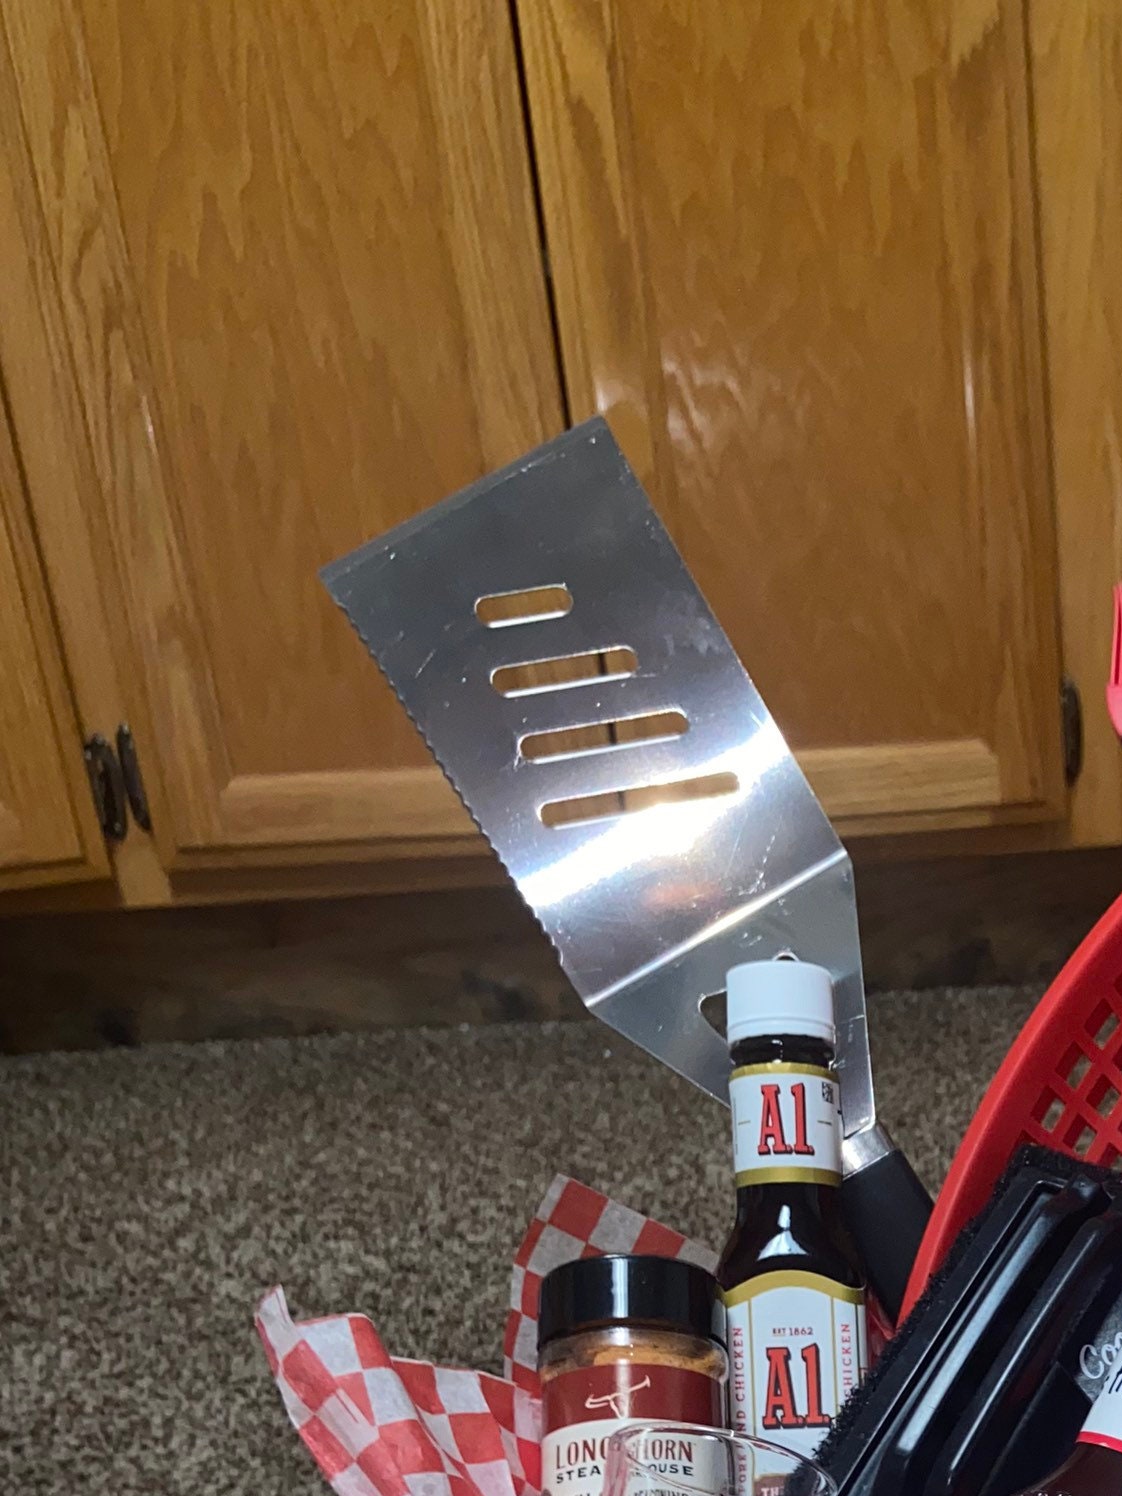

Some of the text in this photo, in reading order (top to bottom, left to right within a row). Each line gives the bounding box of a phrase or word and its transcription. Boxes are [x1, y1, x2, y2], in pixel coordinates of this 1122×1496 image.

[789, 1326, 813, 1336] 1862
[732, 1327, 746, 1401] CHICKEN
[556, 1464, 694, 1485] STEAOUSE
